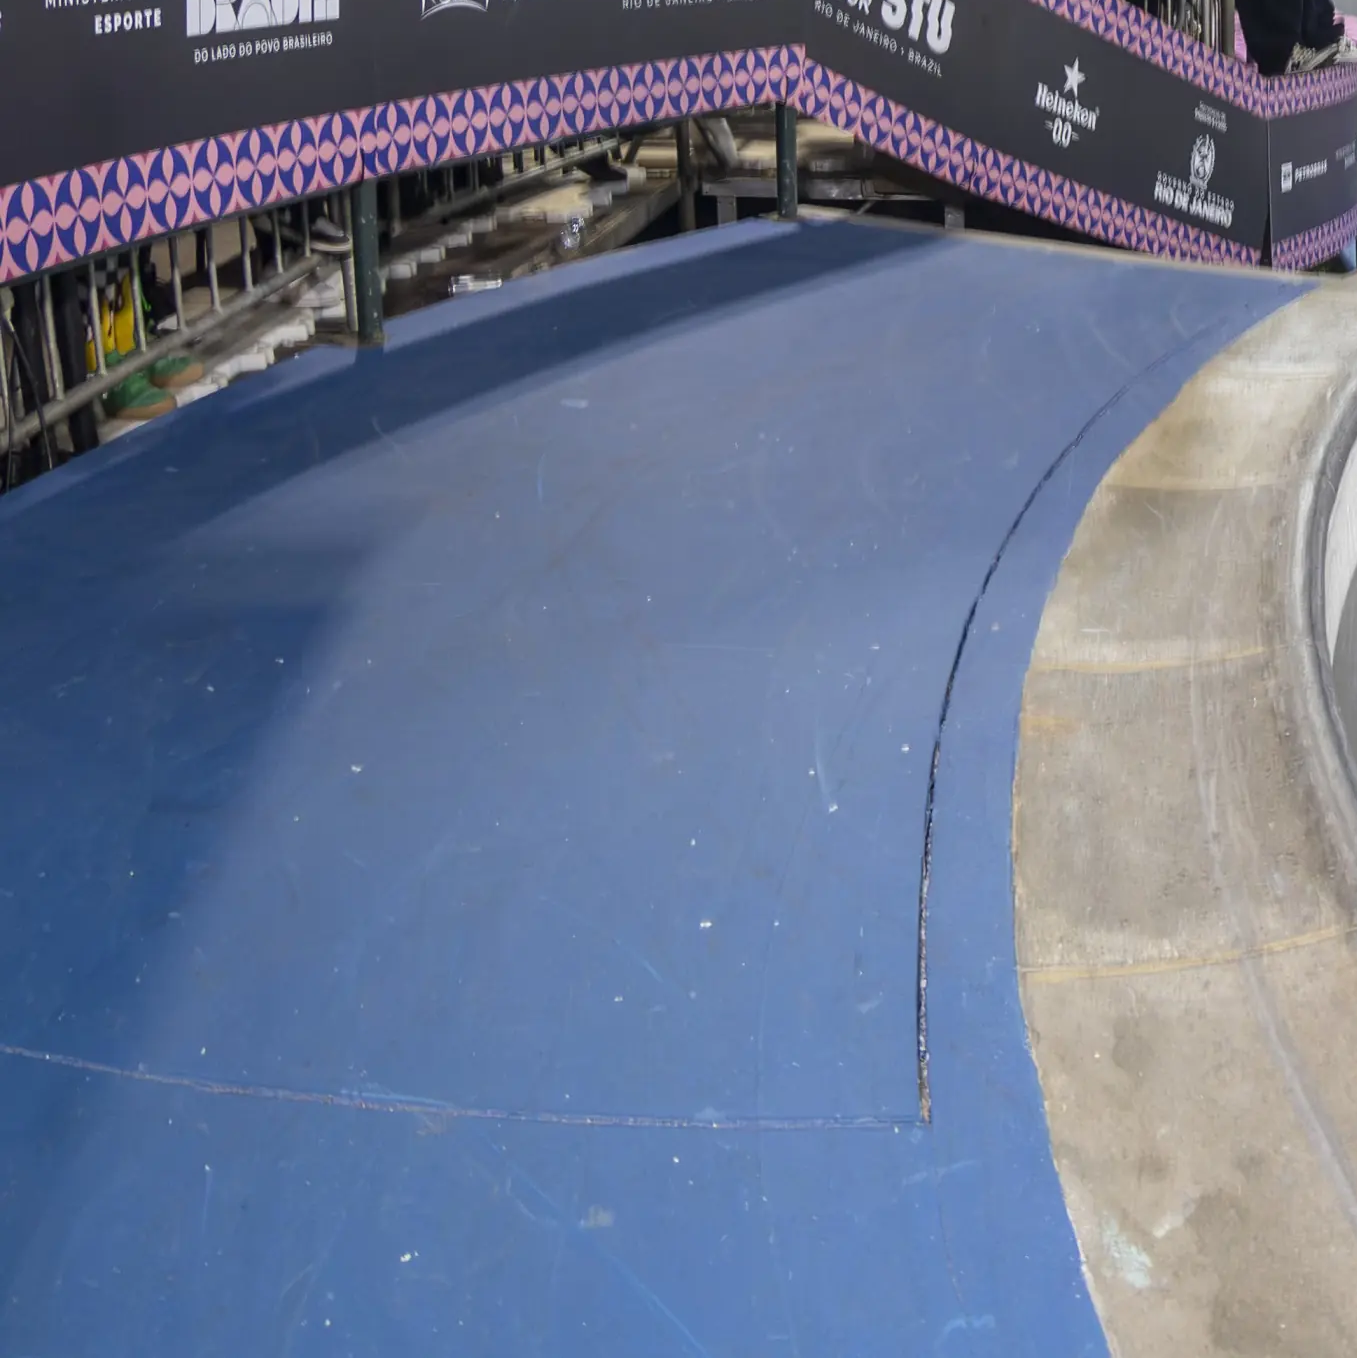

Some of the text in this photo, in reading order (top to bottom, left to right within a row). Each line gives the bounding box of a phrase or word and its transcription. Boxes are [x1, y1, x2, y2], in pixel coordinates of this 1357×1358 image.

[94, 8, 163, 35] ESPORTE
[836, 9, 851, 29] DE
[853, 19, 898, 54] JANEIRO
[907, 48, 943, 78] BRAZIL
[194, 31, 334, 64] DO LADO DO POVO BRASILEIRO
[1035, 82, 1098, 131] Heineken
[1154, 181, 1232, 229] RIO DE JANEIRO
